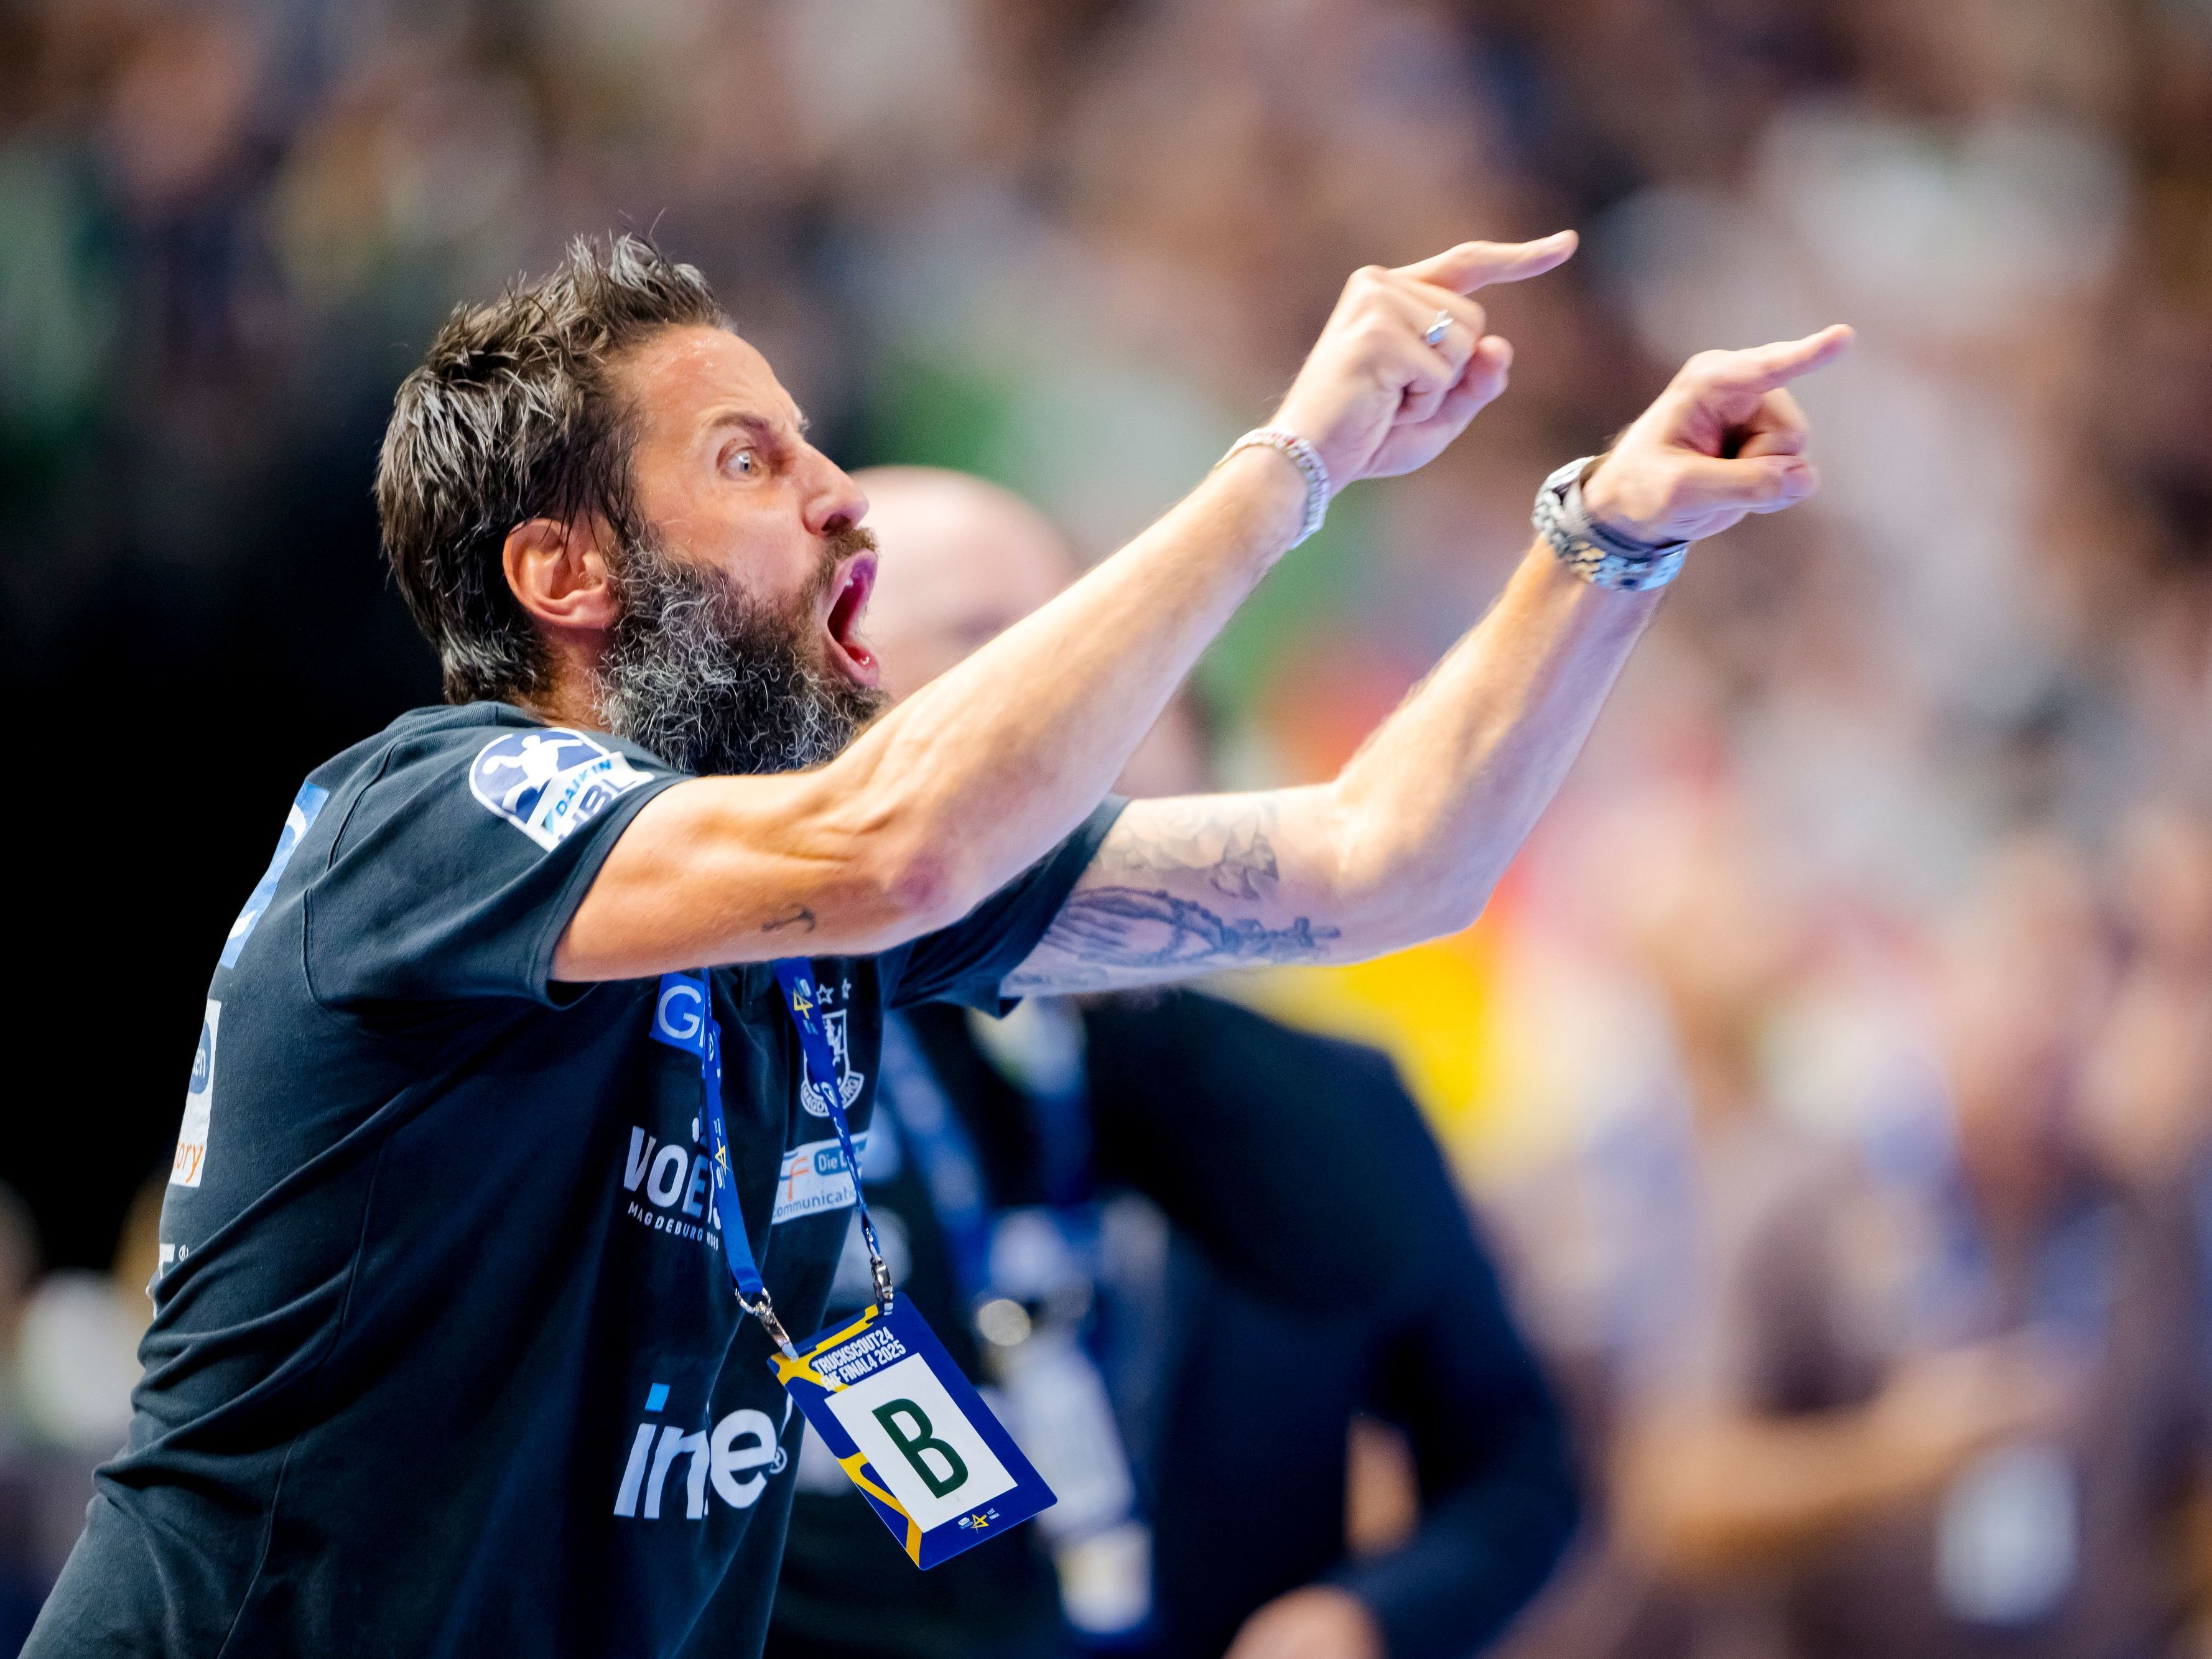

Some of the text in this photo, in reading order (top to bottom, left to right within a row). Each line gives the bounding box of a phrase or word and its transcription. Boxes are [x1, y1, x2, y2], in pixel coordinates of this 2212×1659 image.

[555, 759, 611, 817] DAIKIN
[623, 1125, 715, 1225] VOE
[818, 1152, 837, 1172] Die
[628, 1201, 704, 1242] MAGDEBURG
[811, 1326, 895, 1376] TRUCKSCOUT24
[838, 1353, 878, 1383] FINAL4
[873, 1339, 906, 1365] 2025
[871, 1398, 969, 1500] B
